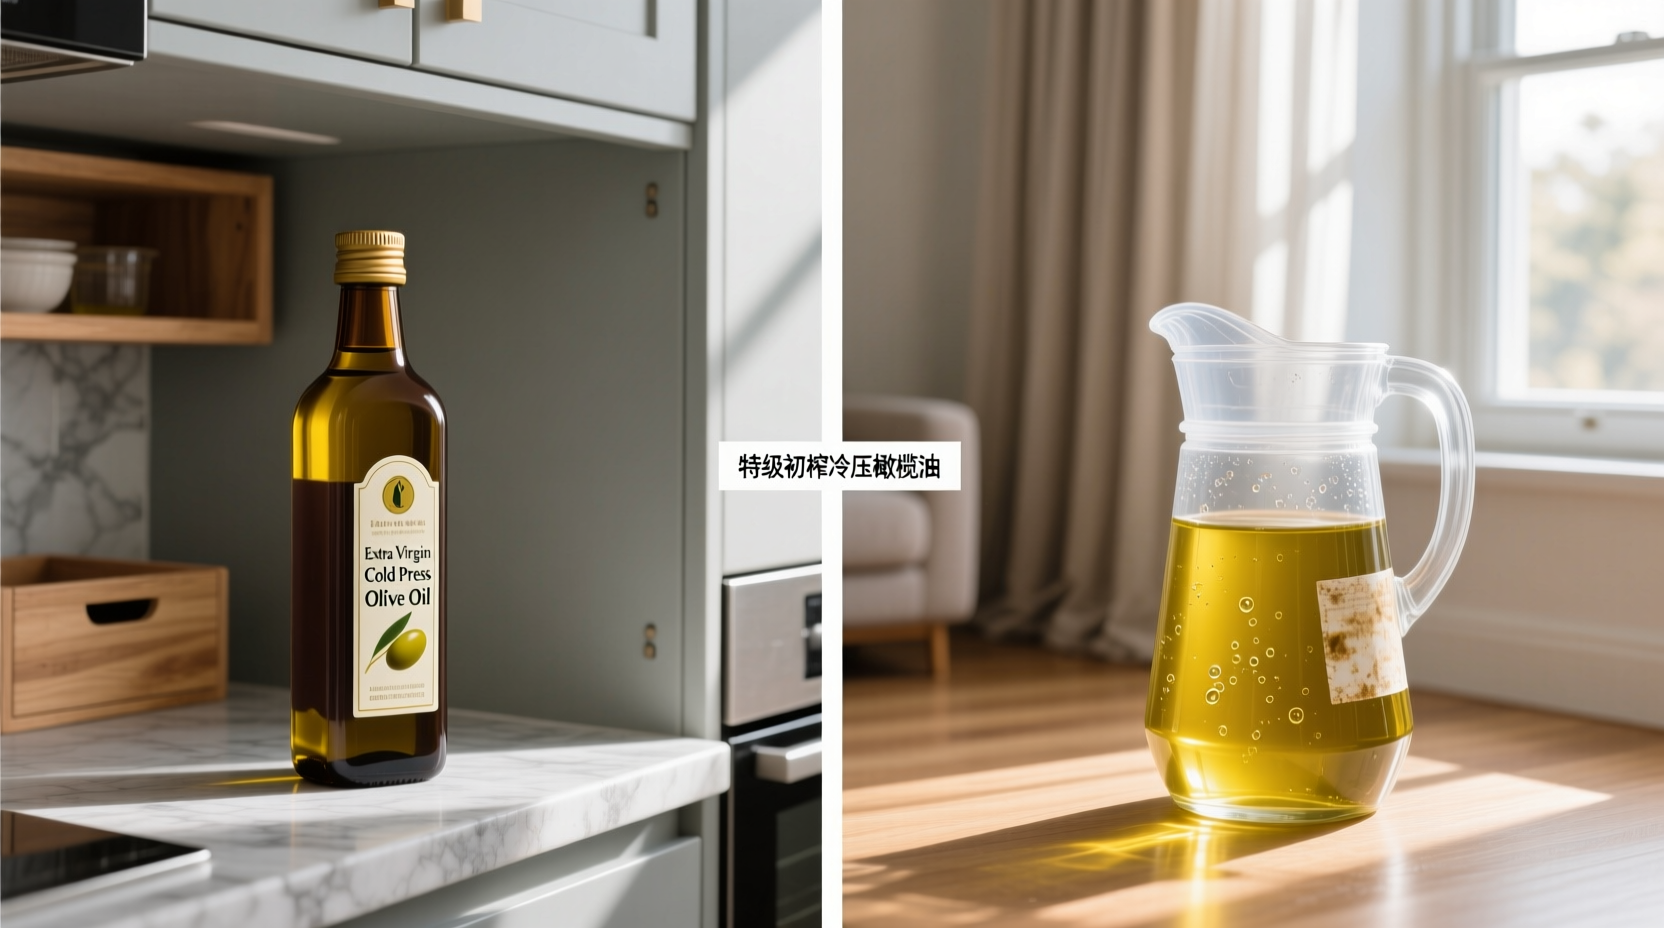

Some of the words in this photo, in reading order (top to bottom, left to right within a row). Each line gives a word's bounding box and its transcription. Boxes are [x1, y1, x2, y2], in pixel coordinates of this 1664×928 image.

[364, 547, 393, 560] Extra
[395, 545, 431, 563] Virgin
[364, 566, 395, 583] Cold
[399, 566, 432, 582] Press
[364, 589, 405, 608] Olive
[408, 587, 430, 606] Oil
